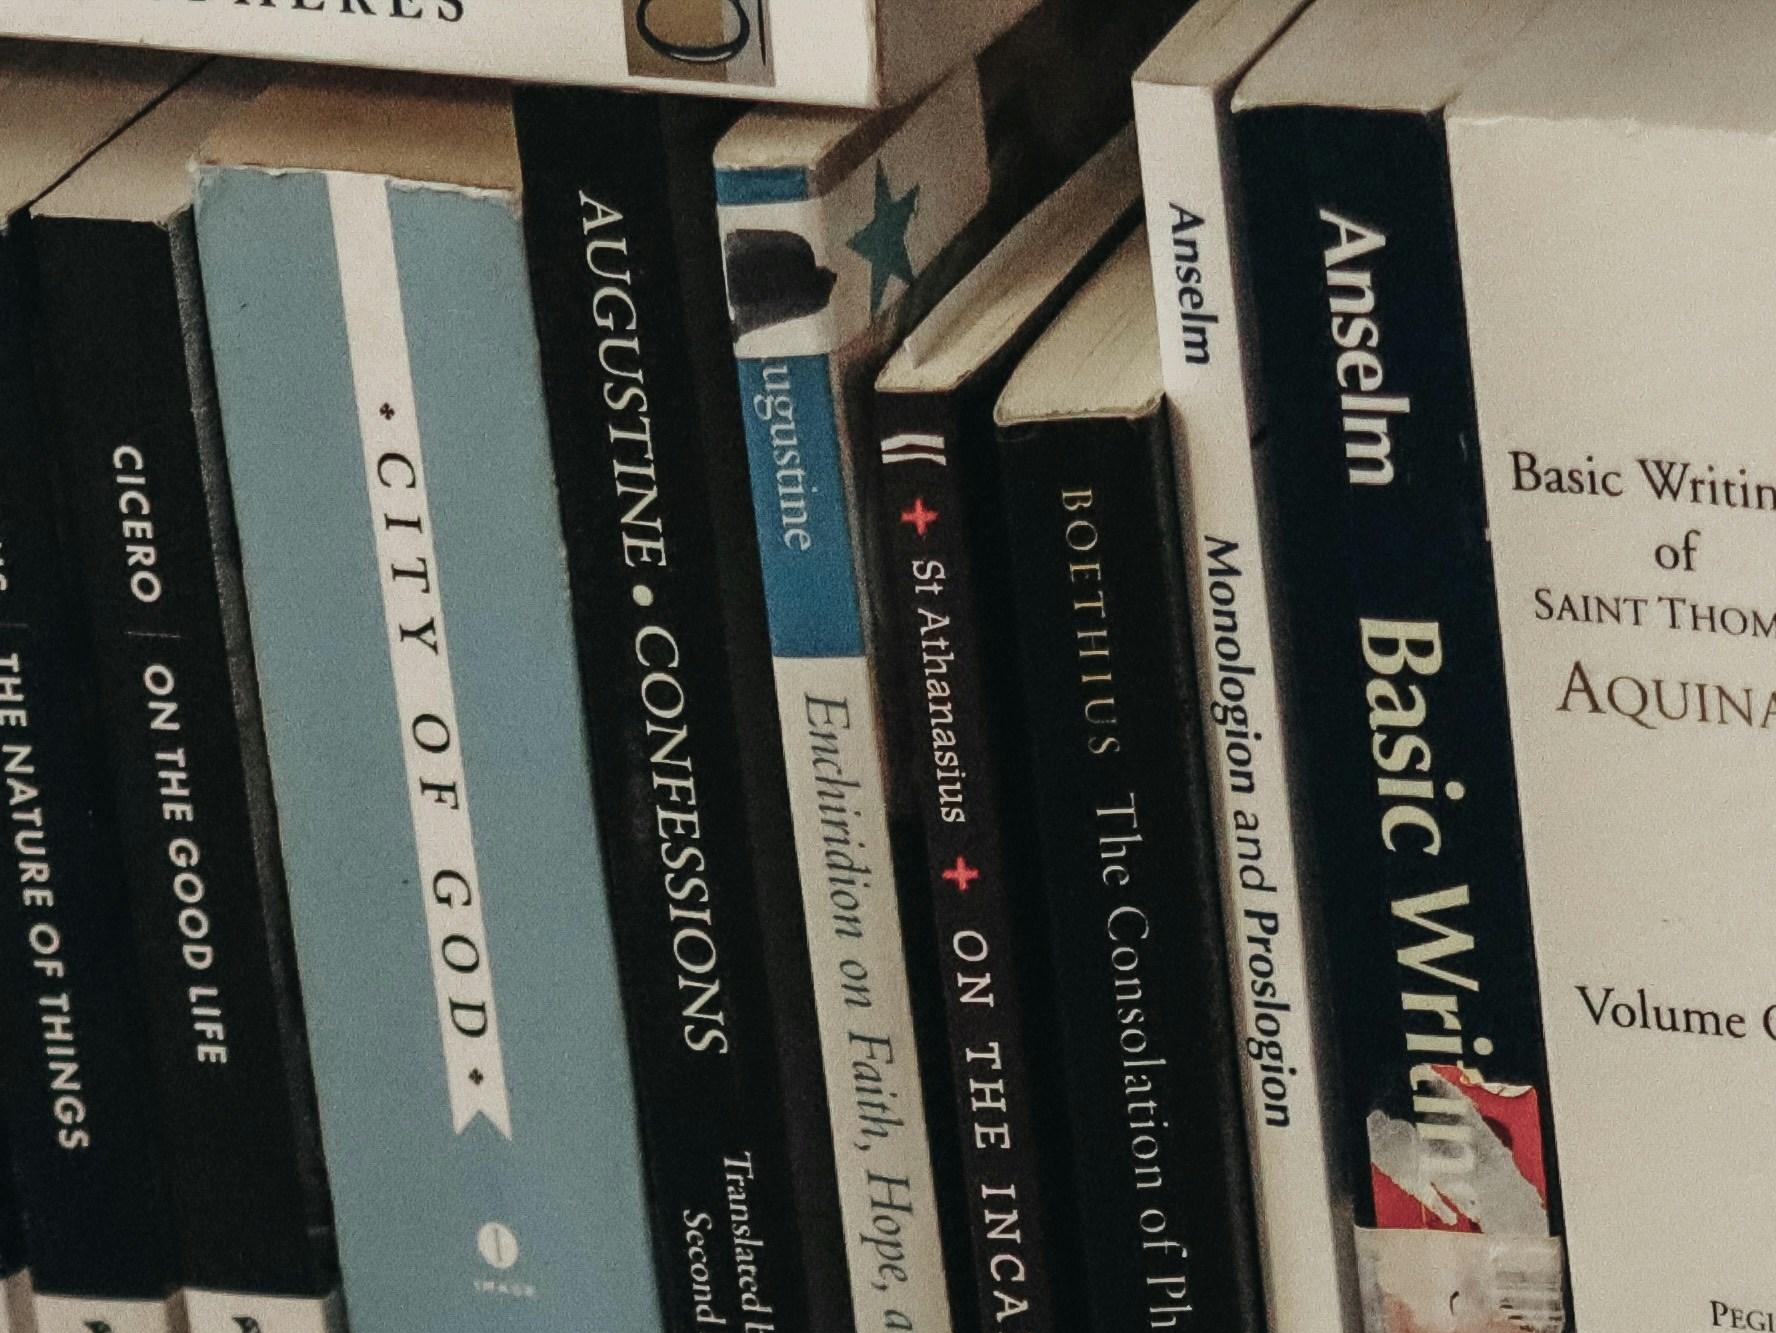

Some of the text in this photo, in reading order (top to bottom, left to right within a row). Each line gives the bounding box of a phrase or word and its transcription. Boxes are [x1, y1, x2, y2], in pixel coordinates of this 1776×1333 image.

[753, 358, 814, 553] ugustine
[1507, 450, 1625, 497] Basic
[912, 558, 943, 593] St
[1319, 208, 1467, 858] Anselm Basic
[1654, 529, 1701, 572] of
[579, 189, 729, 1056] AUGUSTINE CONFESSIONS
[1060, 487, 1120, 757] BOETHIUS
[1169, 201, 1297, 1129] Anselm Monologion and Proslogion
[1533, 587, 1649, 627] SAINT
[112, 445, 227, 1064] CICERO ON THE GOOD LIFE
[376, 451, 489, 1038] CITY OF GOD
[916, 607, 965, 825] Athanasius
[1, 742, 54, 908] NATURE
[805, 690, 873, 940] Enchiridion
[1096, 791, 1142, 886] The
[28, 921, 64, 980] OF
[840, 958, 872, 1008] on
[952, 930, 995, 1008] ON
[1574, 985, 1748, 1039] Volume
[39, 993, 90, 1152] THINGS
[847, 1029, 905, 1152] Faith,
[964, 1041, 1010, 1150] THE
[1106, 905, 1169, 1192] Consolation
[683, 1209, 725, 1325] Second
[724, 1151, 774, 1314] Translated
[860, 1170, 913, 1291] Hope,
[1139, 1206, 1189, 1258] of
